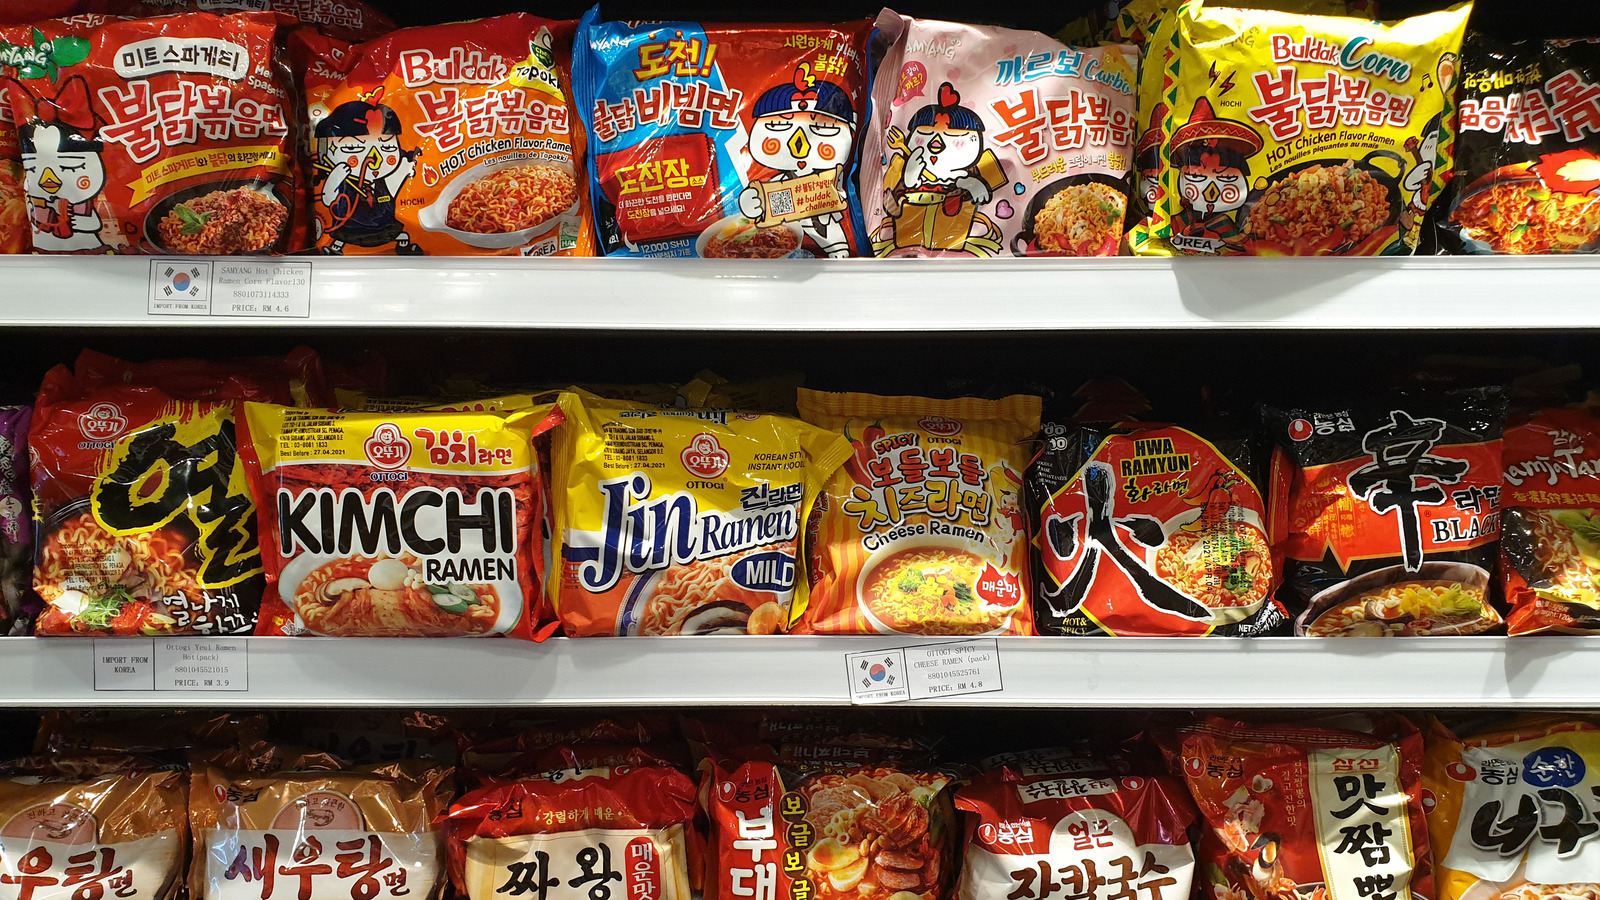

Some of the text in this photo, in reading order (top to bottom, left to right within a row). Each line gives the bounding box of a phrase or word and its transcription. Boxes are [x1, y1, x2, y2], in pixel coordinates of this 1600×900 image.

[784, 34, 833, 50] 시원하게
[122, 44, 240, 71] 미트 스파게티
[634, 37, 718, 82] 도전!
[814, 53, 848, 77] 불닭!
[1271, 33, 1413, 84] Buldak Corn
[400, 48, 506, 88] Buldak
[995, 50, 1085, 85] 까르보
[1220, 100, 1242, 108] HOCHI
[1247, 66, 1415, 141] 불닭볶음면
[98, 80, 288, 163] 불닭볶음면
[414, 88, 569, 152] 불닭볶음면
[440, 136, 545, 177] HOT Chicken Flavor
[1266, 130, 1395, 165] HOT Chicken Flavor Ramen
[208, 152, 236, 168] 불닭의
[484, 156, 496, 166] Les
[497, 152, 528, 164] nouilles
[539, 152, 568, 162] Topokki
[1031, 151, 1126, 183] 부드러운 크림에 불닭!
[1270, 162, 1283, 173] Les
[1284, 152, 1312, 169] nouilles
[1313, 142, 1350, 157] piquantes
[615, 158, 690, 194] 도전장
[400, 198, 425, 206] HOCHI
[625, 198, 644, 207] 화끈한
[646, 195, 664, 205] 도전을
[666, 192, 692, 202] 원한다면
[627, 205, 686, 220] 도전장을 넣으세요!
[670, 240, 690, 249] SHU
[221, 267, 252, 275] SAMYANG
[256, 267, 268, 275] Hot
[266, 278, 305, 286] Flavor130
[86, 421, 118, 433] 오뚜기
[1313, 418, 1356, 436] 농심
[873, 432, 916, 456] SPICY
[927, 437, 961, 445] OTTOGI
[1135, 438, 1174, 457] HWA
[372, 445, 404, 460] 오뚜기
[689, 454, 727, 470] 오뚜기
[754, 453, 788, 461] KOREAN
[748, 462, 782, 471] INSTANT
[868, 448, 986, 489] 보들보들
[1121, 455, 1190, 477] RAMYUN
[370, 472, 408, 482] OTTOGI
[686, 481, 724, 490] OTTOGI
[740, 482, 802, 510] 진라면
[1123, 478, 1190, 504] 화라면
[1346, 410, 1470, 573] 辛
[843, 480, 991, 531] 치즈라면
[278, 489, 514, 556] KIMCHI
[579, 472, 698, 592] Jin
[700, 507, 794, 555] Ramen
[1432, 514, 1498, 543] BLACK
[863, 520, 984, 552] Cheese Ramen
[1040, 461, 1216, 618] 火
[426, 558, 514, 583] RAMEN
[745, 561, 795, 588] MILD
[1202, 540, 1213, 591] 2021.APR.04
[981, 580, 1018, 599] 매운맛
[1061, 626, 1087, 635] SPICY
[1062, 617, 1088, 626] HOT&
[1238, 623, 1252, 632] NET
[954, 646, 976, 654] SPICY
[914, 654, 990, 669] CHEESE RAMEN (pack)
[927, 669, 980, 680] 8801045525761
[1207, 761, 1244, 779] 농심
[1332, 758, 1380, 771] 삼선
[1529, 754, 1576, 782] 순한
[1480, 767, 1518, 786] 농심
[735, 784, 770, 803] 농심
[542, 807, 614, 825] 강렬하게 매운
[997, 827, 1034, 845] 농심
[1067, 818, 1114, 851] 얼큰
